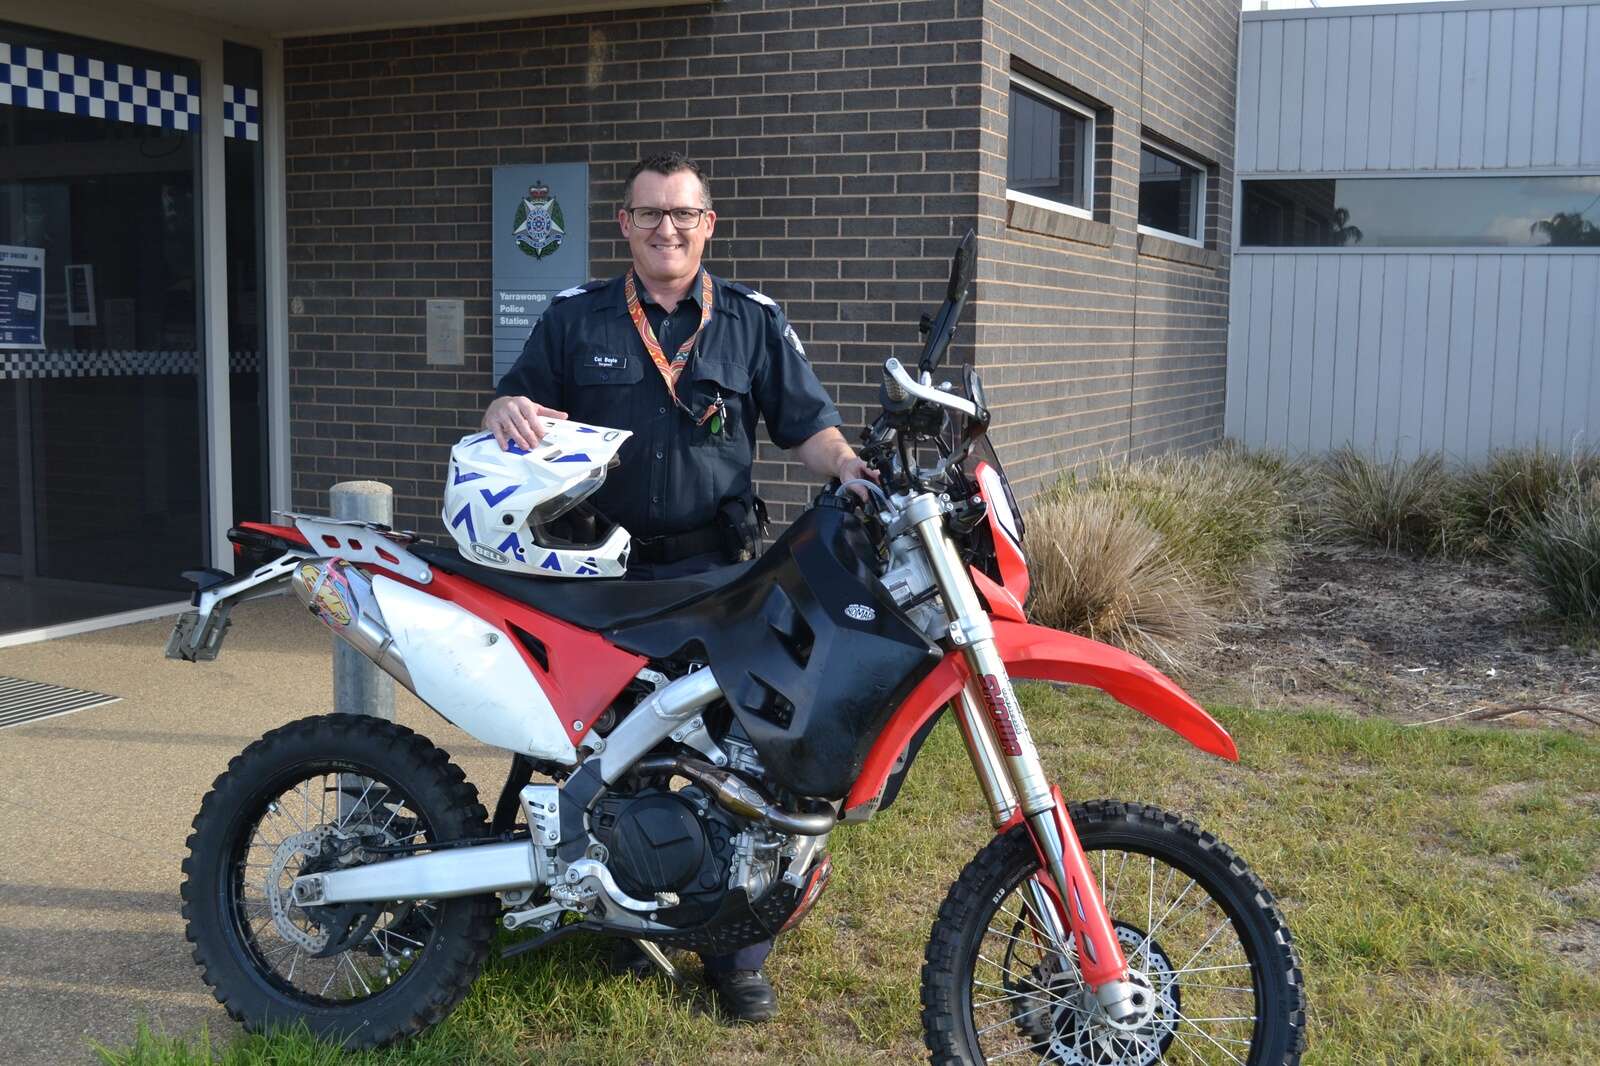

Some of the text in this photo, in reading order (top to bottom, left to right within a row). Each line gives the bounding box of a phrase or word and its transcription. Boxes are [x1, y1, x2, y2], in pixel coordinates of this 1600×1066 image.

[500, 292, 546, 302] Yarrawonga
[500, 305, 524, 313] Police
[500, 317, 529, 325] Station
[475, 545, 503, 561] BELL
[977, 674, 1022, 756] SHOWA
